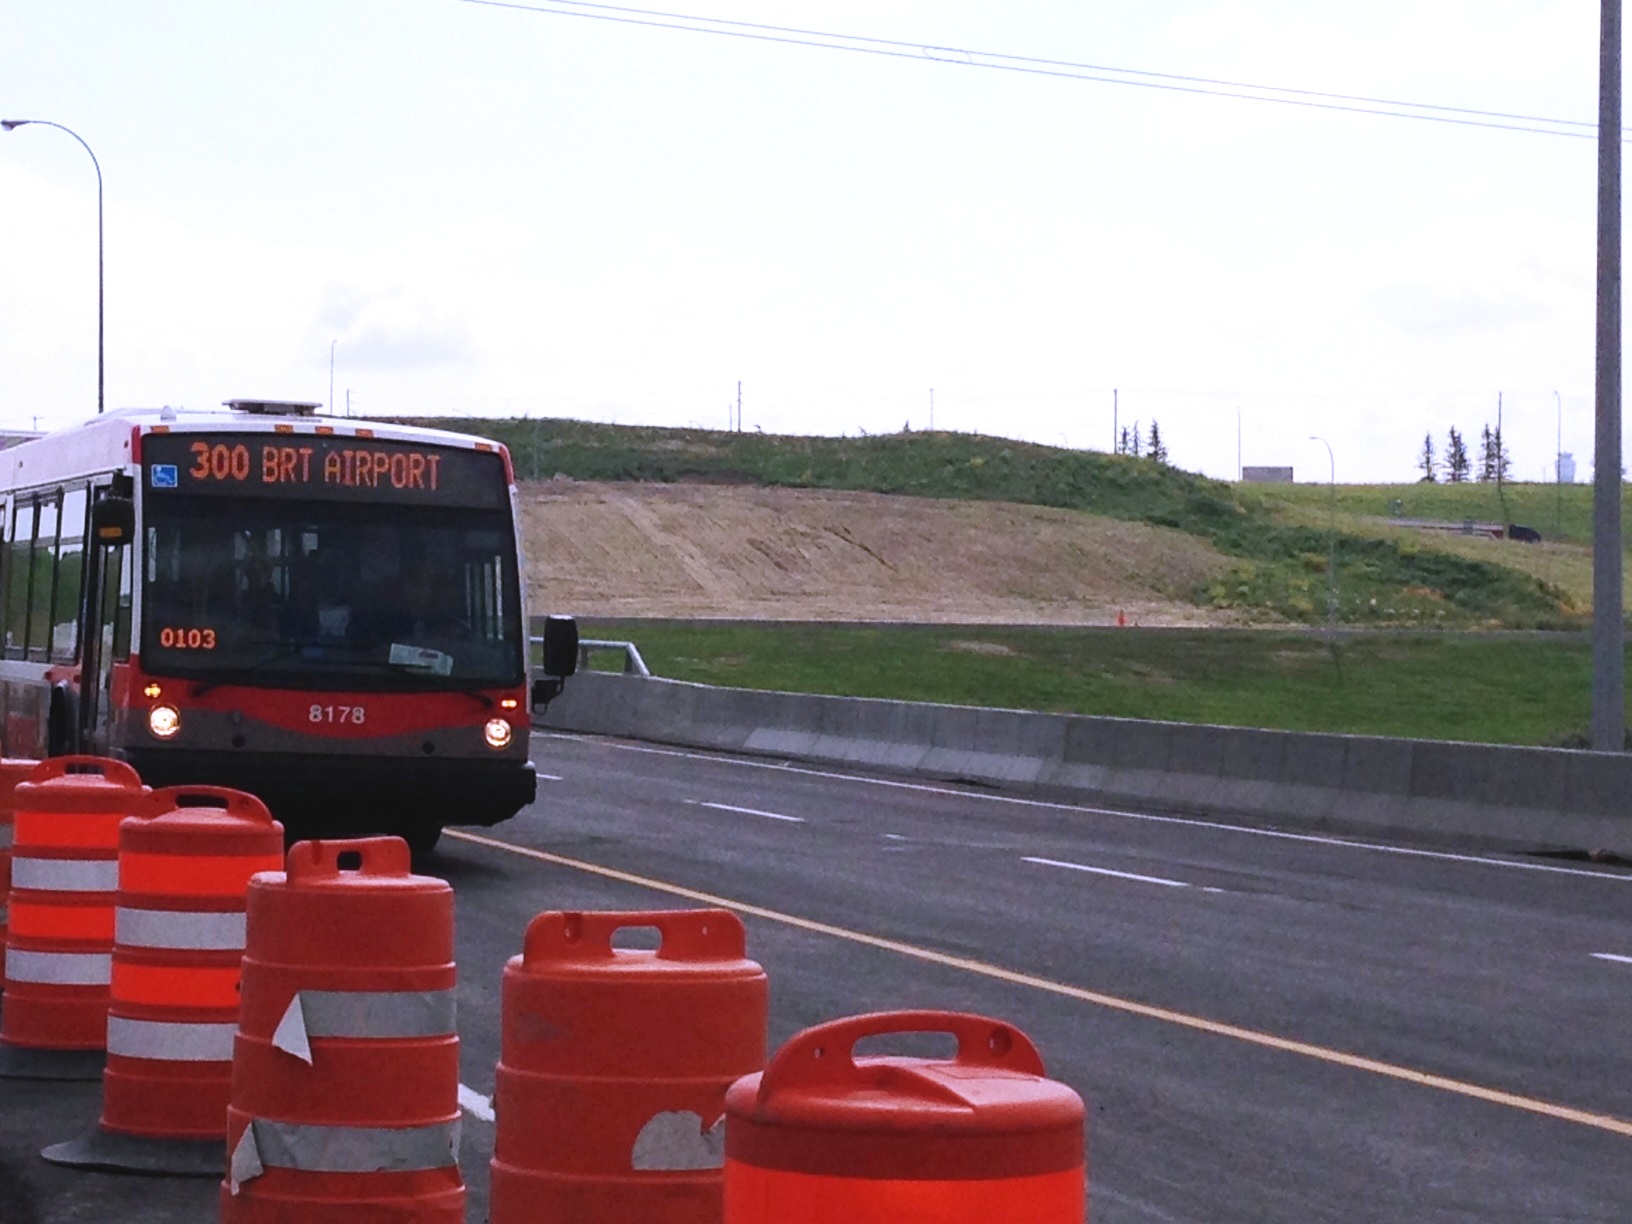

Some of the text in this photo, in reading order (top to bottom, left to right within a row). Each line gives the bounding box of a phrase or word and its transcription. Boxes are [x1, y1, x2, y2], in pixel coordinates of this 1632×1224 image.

[190, 442, 441, 490] 300 BRT AIRPORT
[160, 628, 217, 649] 0103
[308, 705, 366, 724] 8178
